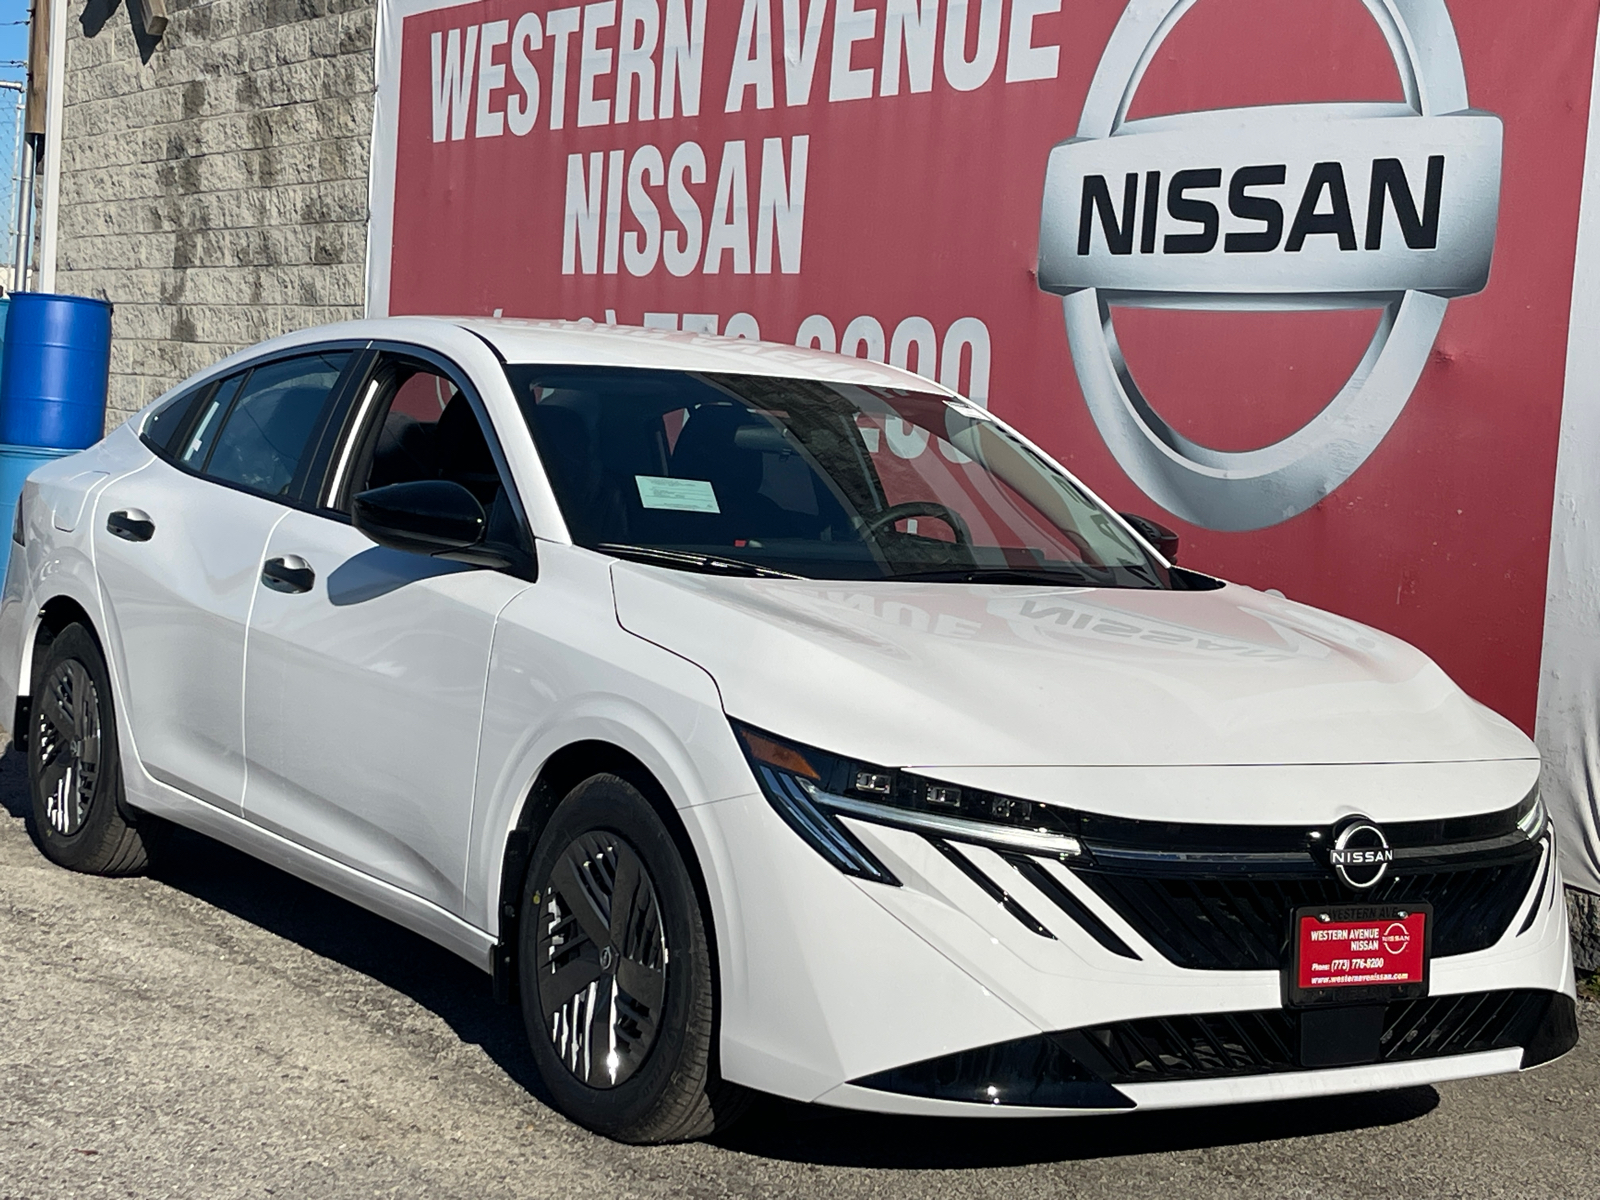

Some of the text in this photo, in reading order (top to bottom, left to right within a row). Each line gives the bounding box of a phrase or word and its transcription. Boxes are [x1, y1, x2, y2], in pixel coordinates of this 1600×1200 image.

[430, 0, 1062, 143] WESTERN AVENUE
[561, 135, 810, 277] NISSAN
[1077, 155, 1445, 256] NISSAN
[1332, 850, 1393, 863] NISSAN
[1311, 928, 1379, 941] WESTERN AVENUE
[1350, 940, 1379, 951] NISSAN
[1311, 957, 1384, 972] Phone: (773) 776-8200
[1311, 973, 1409, 984] www.westernavenissan.com
